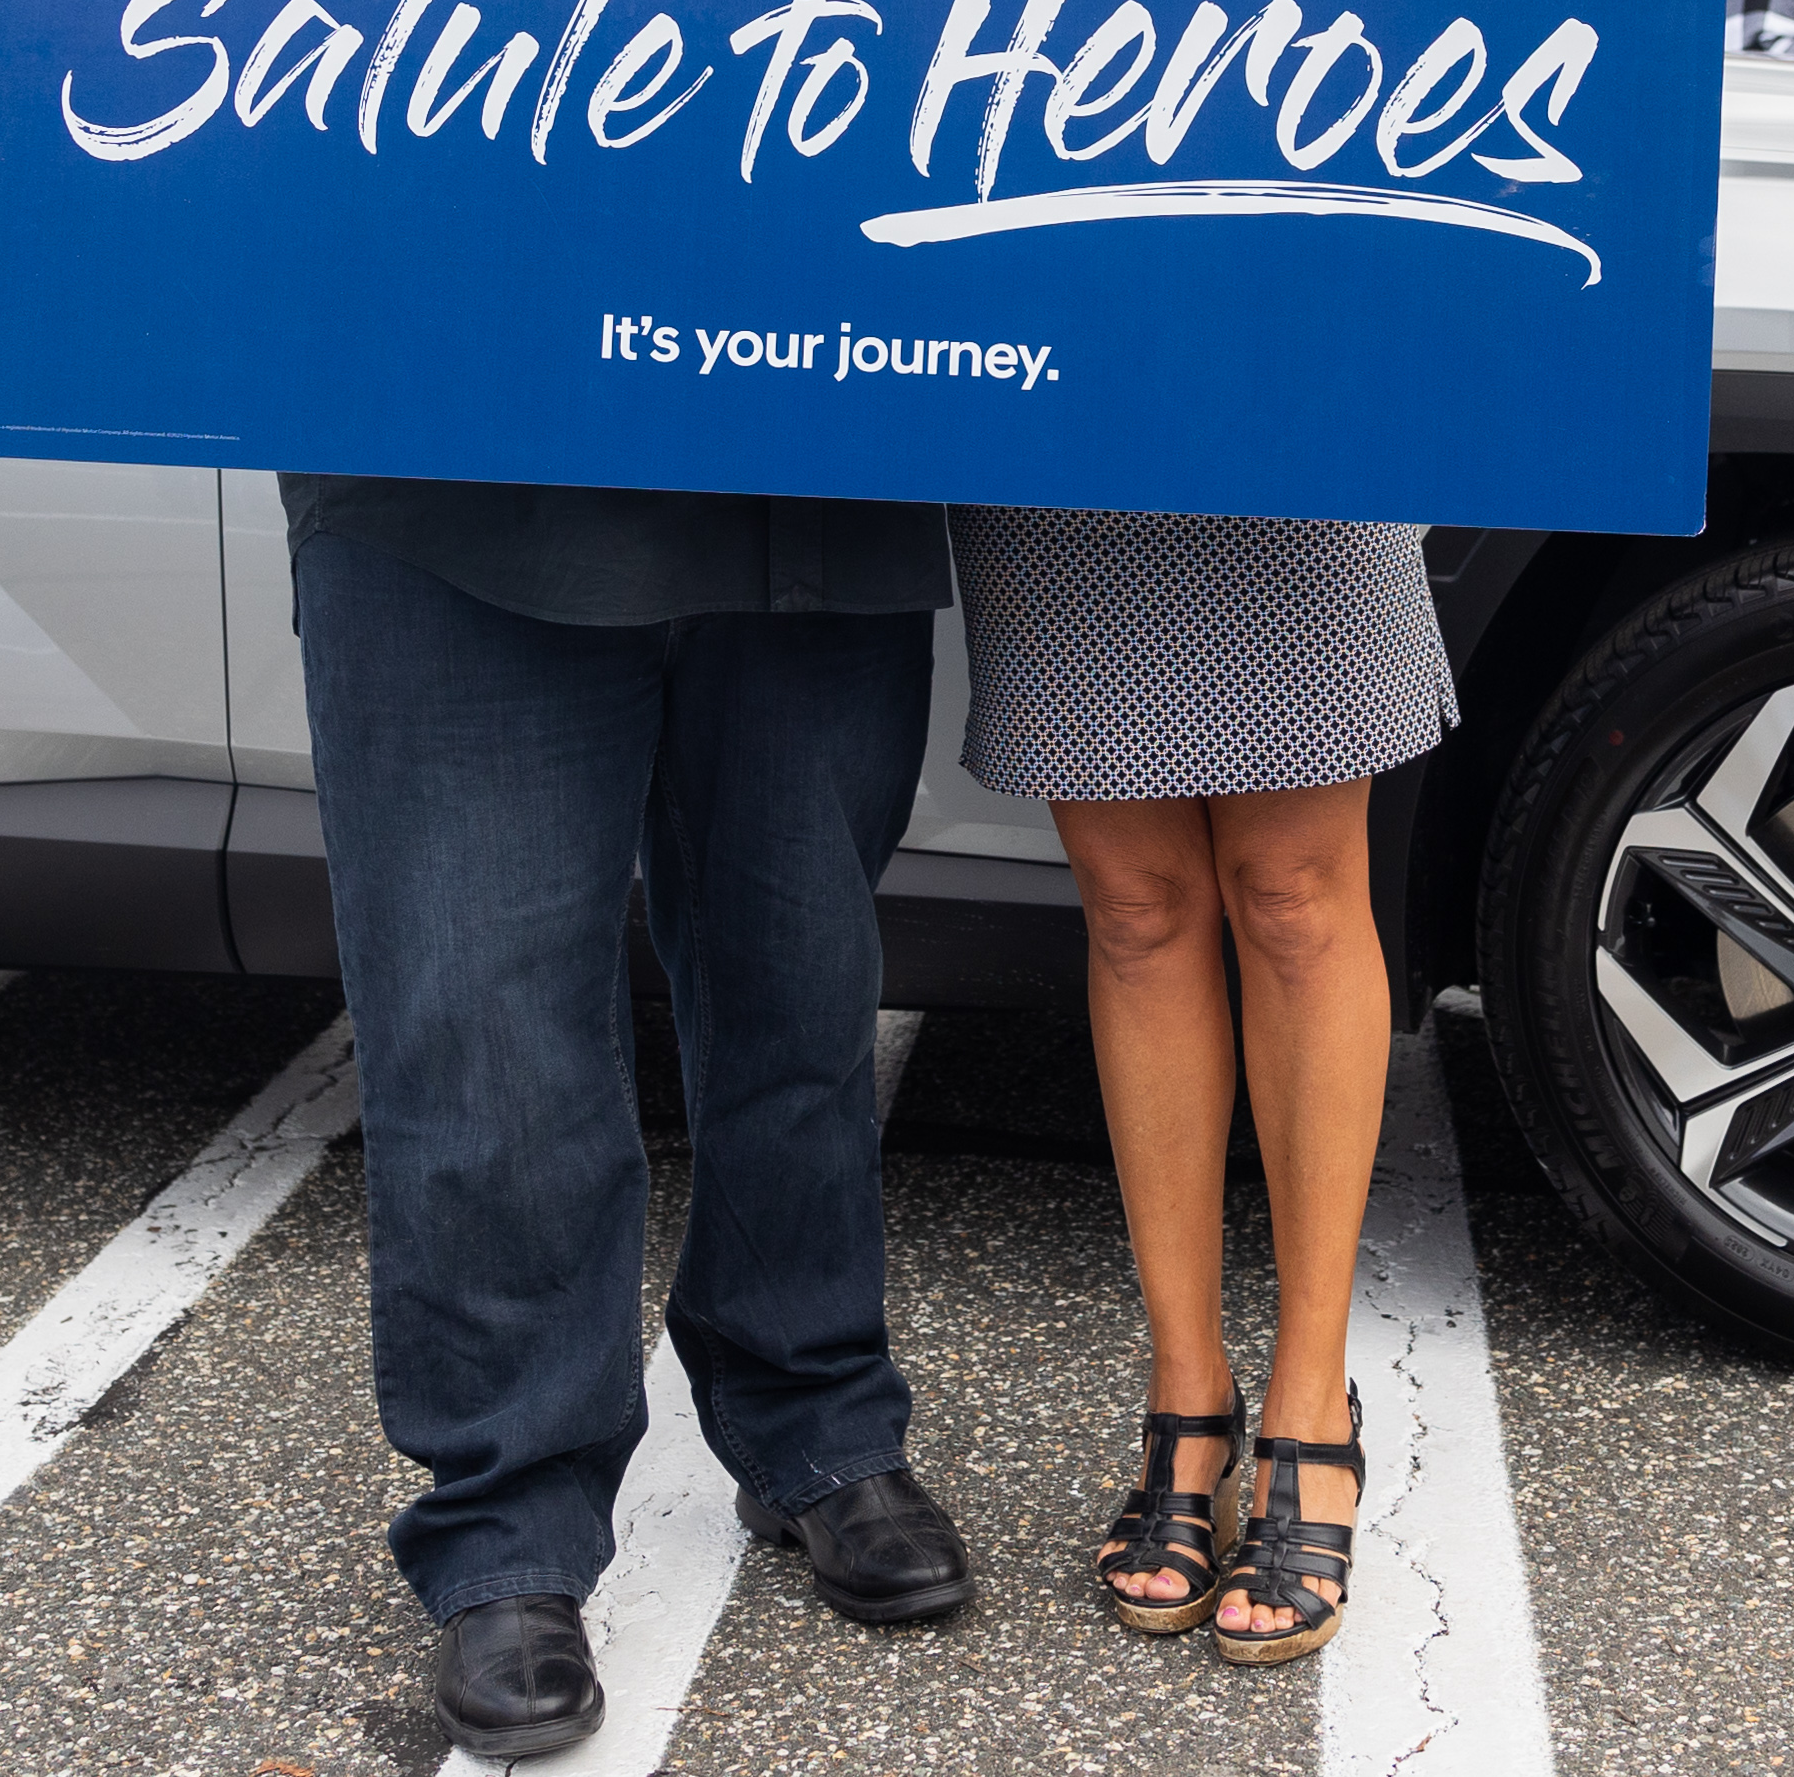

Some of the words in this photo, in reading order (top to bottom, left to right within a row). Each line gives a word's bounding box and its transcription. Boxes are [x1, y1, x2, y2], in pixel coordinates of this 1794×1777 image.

[695, 328, 825, 375] your
[833, 322, 1059, 391] journey.
[1536, 955, 1624, 1176] MICHELIN
